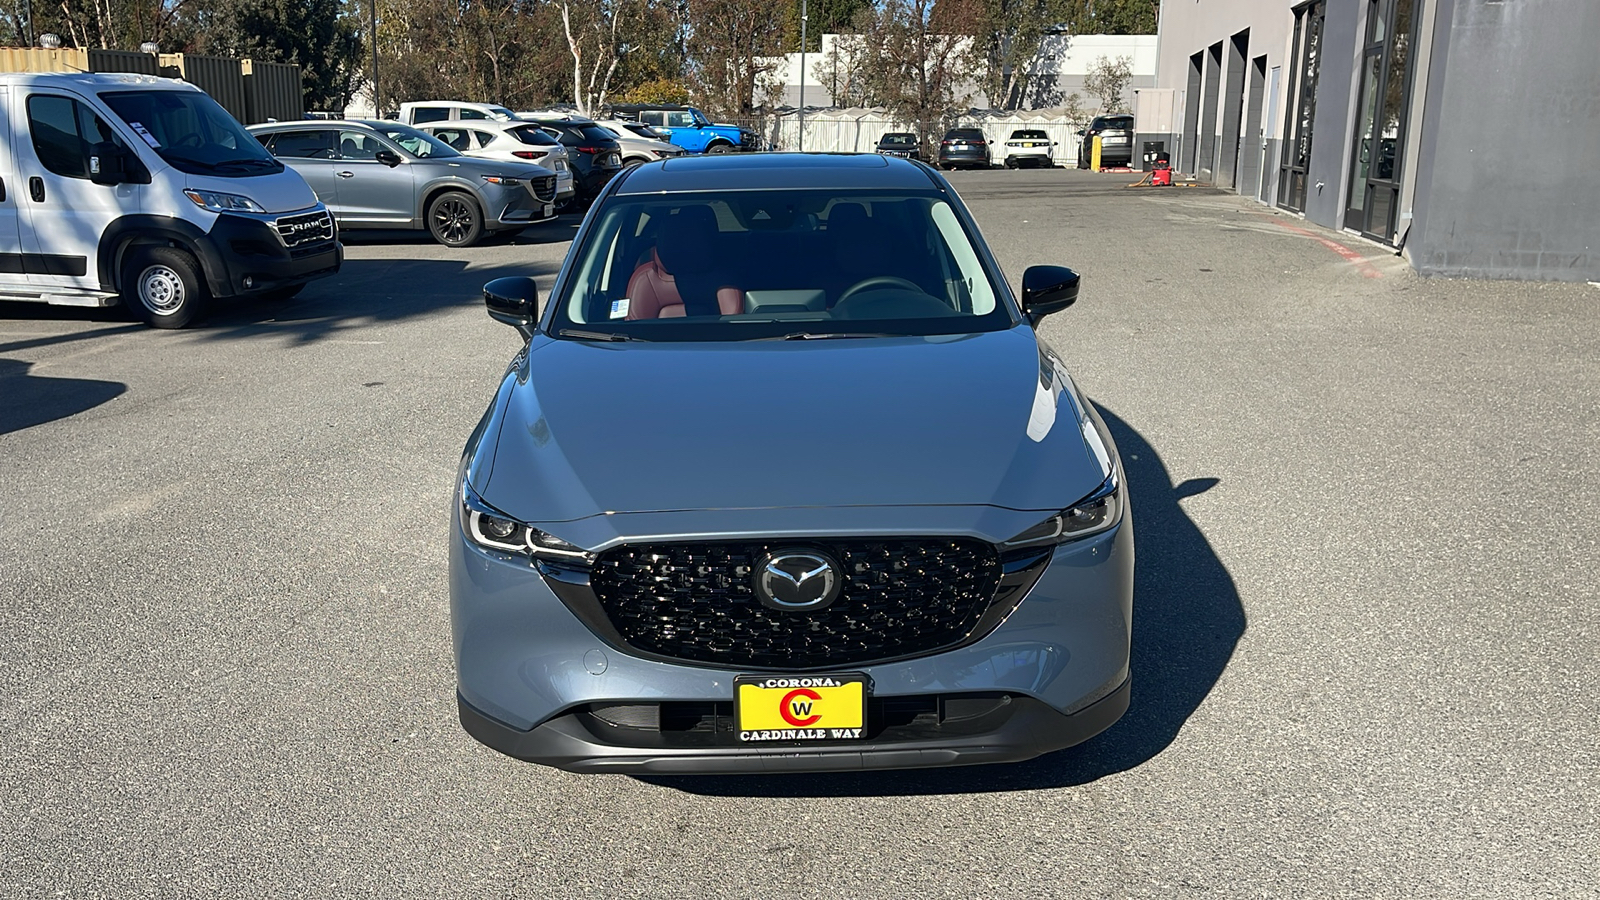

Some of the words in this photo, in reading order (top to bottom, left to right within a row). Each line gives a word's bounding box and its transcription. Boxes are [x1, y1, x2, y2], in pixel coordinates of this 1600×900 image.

[294, 220, 319, 230] RAM
[765, 678, 835, 688] CORONA
[792, 702, 812, 716] W
[740, 729, 826, 741] CARDINALE
[832, 729, 862, 739] WAY
